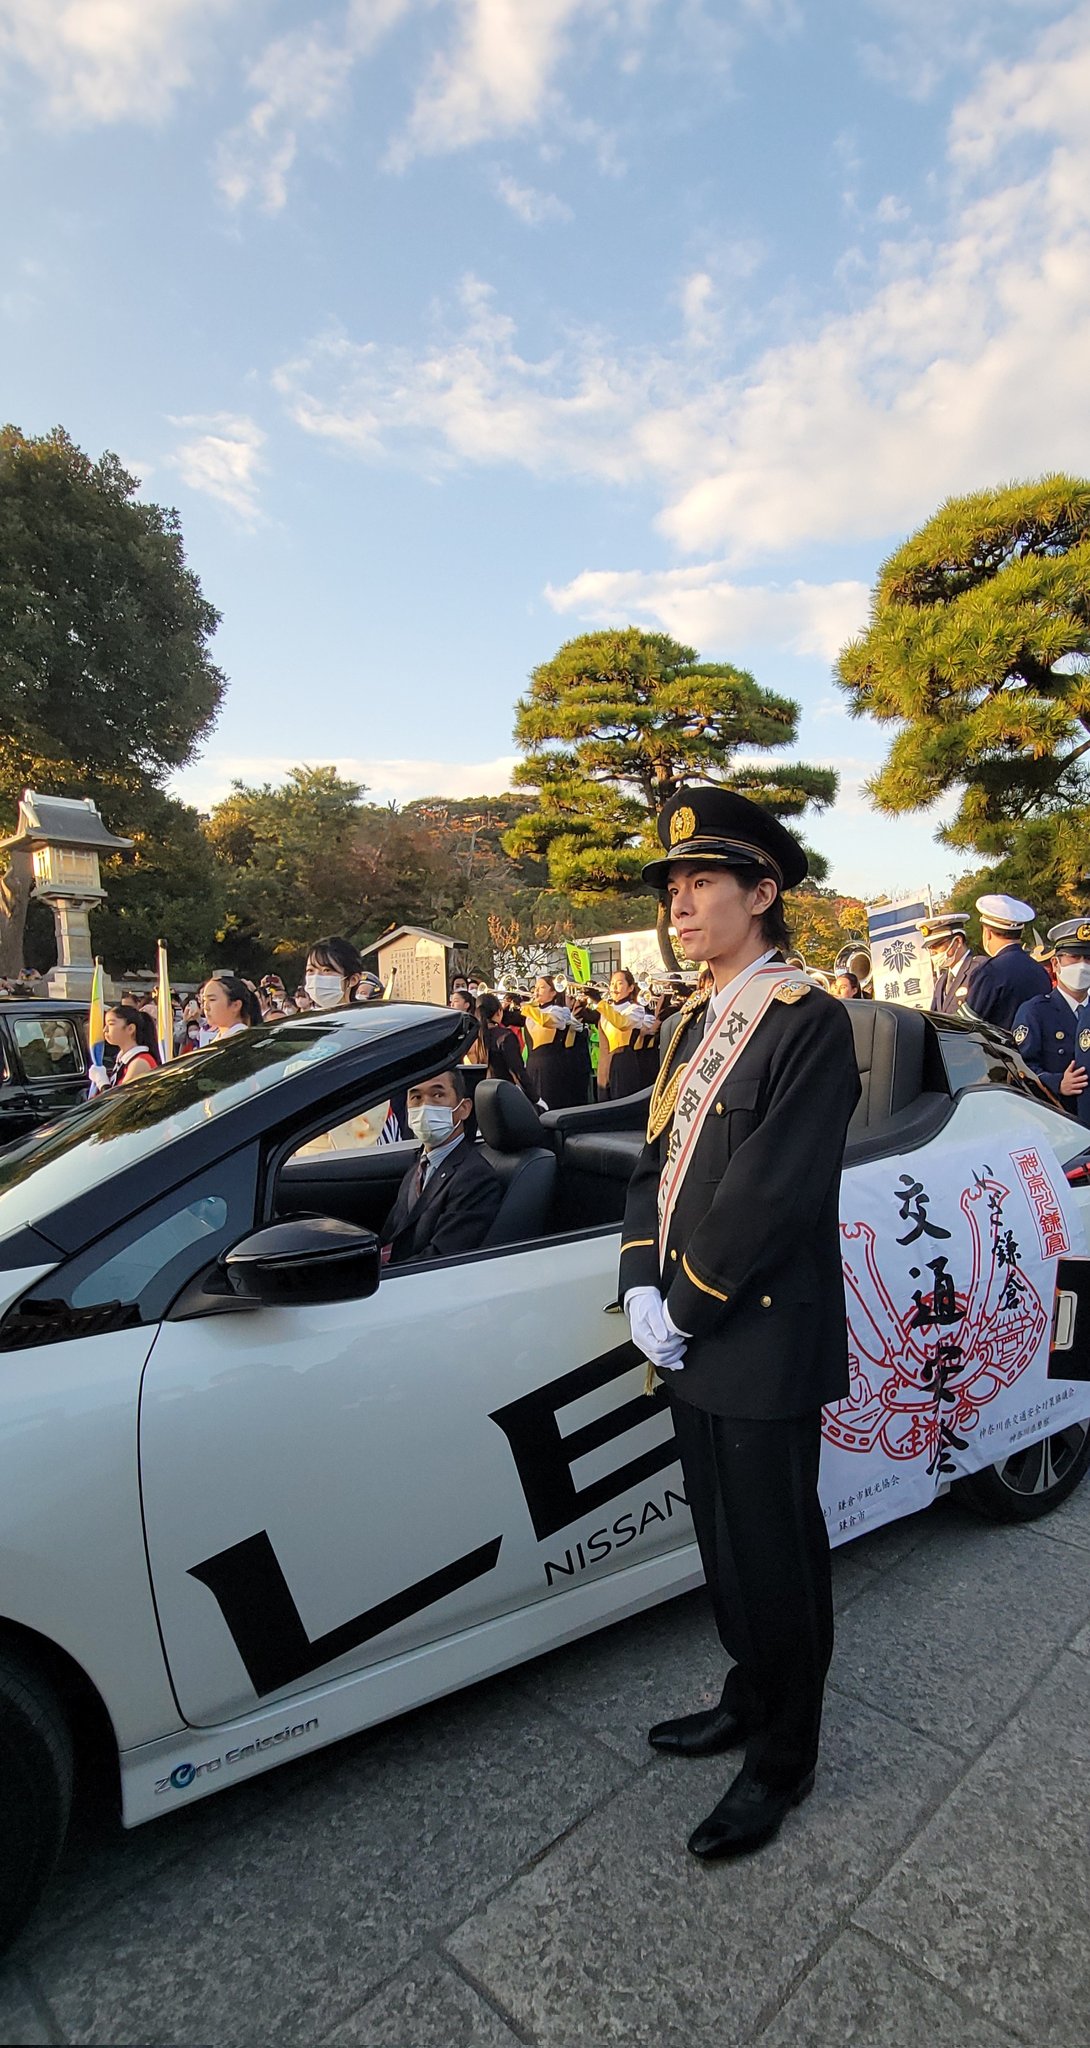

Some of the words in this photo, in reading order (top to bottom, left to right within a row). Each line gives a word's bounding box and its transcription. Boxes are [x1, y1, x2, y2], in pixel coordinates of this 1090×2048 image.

[884, 978, 921, 1000] 鎌倉
[894, 1174, 969, 1487] 交通安全
[544, 1490, 691, 1587] NISSAN
